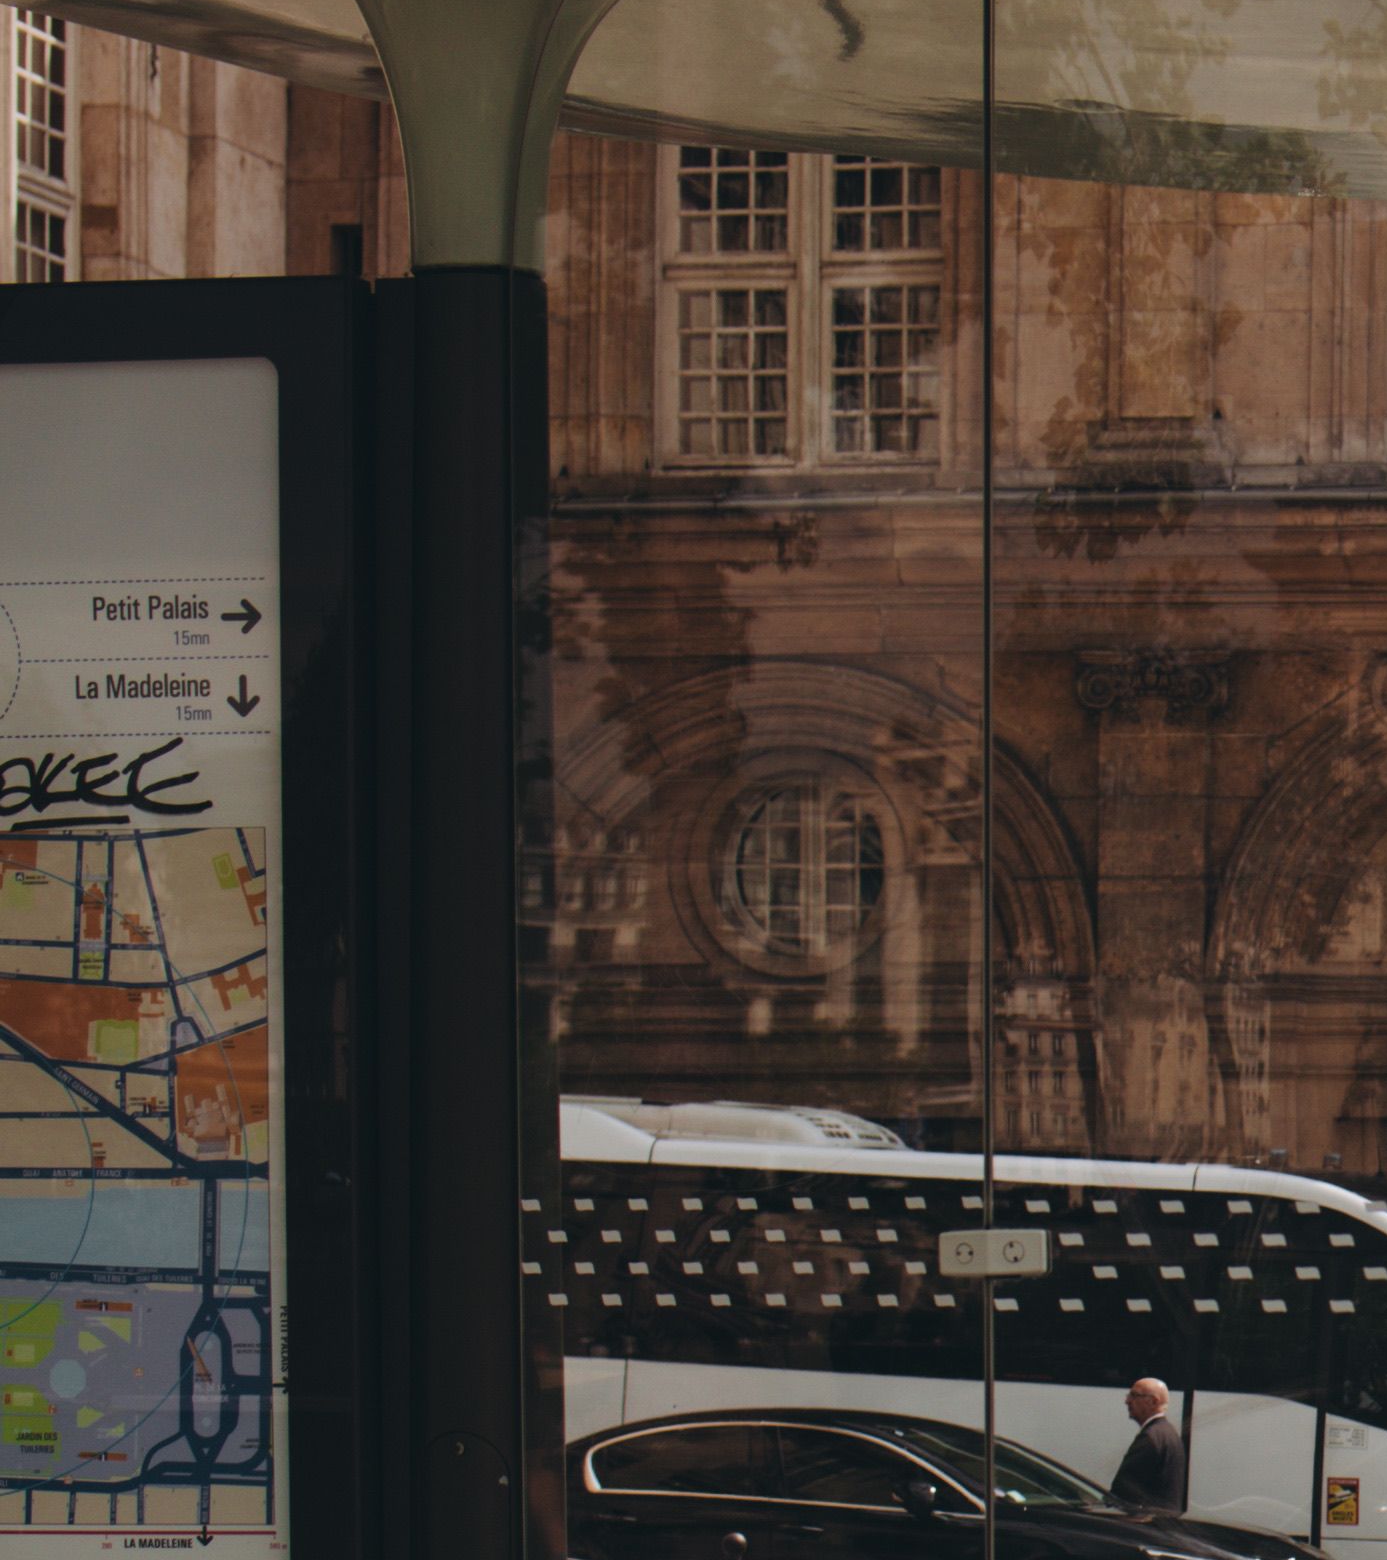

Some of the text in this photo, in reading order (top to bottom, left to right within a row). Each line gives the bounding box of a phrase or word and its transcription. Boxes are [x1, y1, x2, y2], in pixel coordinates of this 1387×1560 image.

[92, 593, 209, 621] Petit Palais
[174, 630, 210, 646] 15mn
[75, 672, 211, 699] La Madeleine
[176, 705, 212, 721] 15mn
[16, 1432, 58, 1441] JARDIN DES
[20, 1444, 55, 1454] TUILERIES
[124, 1538, 193, 1549] LA MADELEINE
